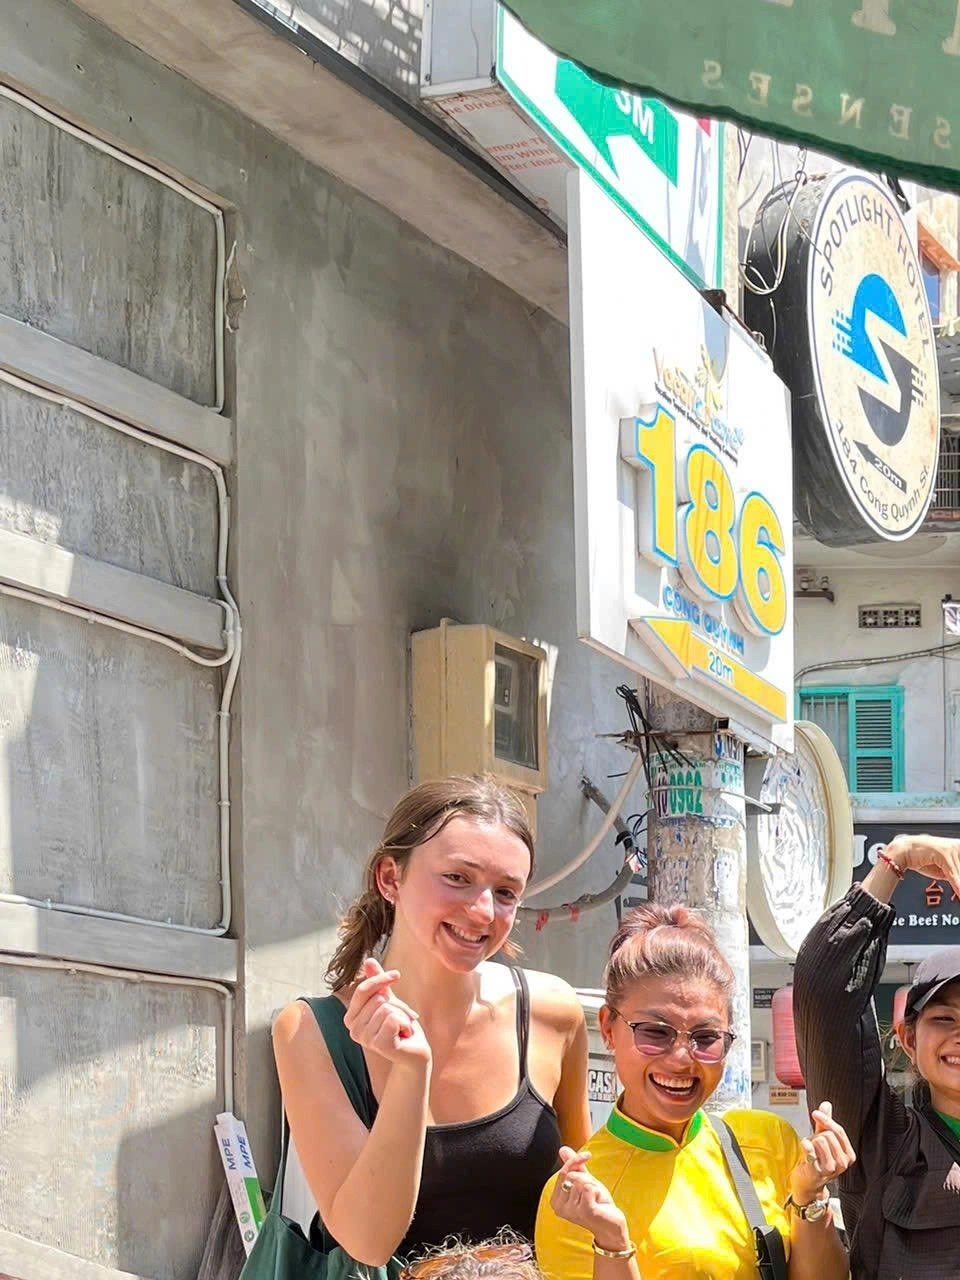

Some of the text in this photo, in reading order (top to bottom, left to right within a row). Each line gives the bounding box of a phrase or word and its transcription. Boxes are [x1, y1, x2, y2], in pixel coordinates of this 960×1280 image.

[820, 194, 932, 351] SPOTLIGHT HOTEL
[836, 418, 857, 474] 184
[860, 475, 889, 521] Cong
[891, 489, 921, 523] Quynh
[873, 457, 903, 488] 20m
[634, 402, 787, 636] 186
[709, 651, 733, 682] 20m
[909, 914, 938, 926] Beef
[222, 1138, 236, 1170] MPE
[237, 1135, 252, 1168] MPE
